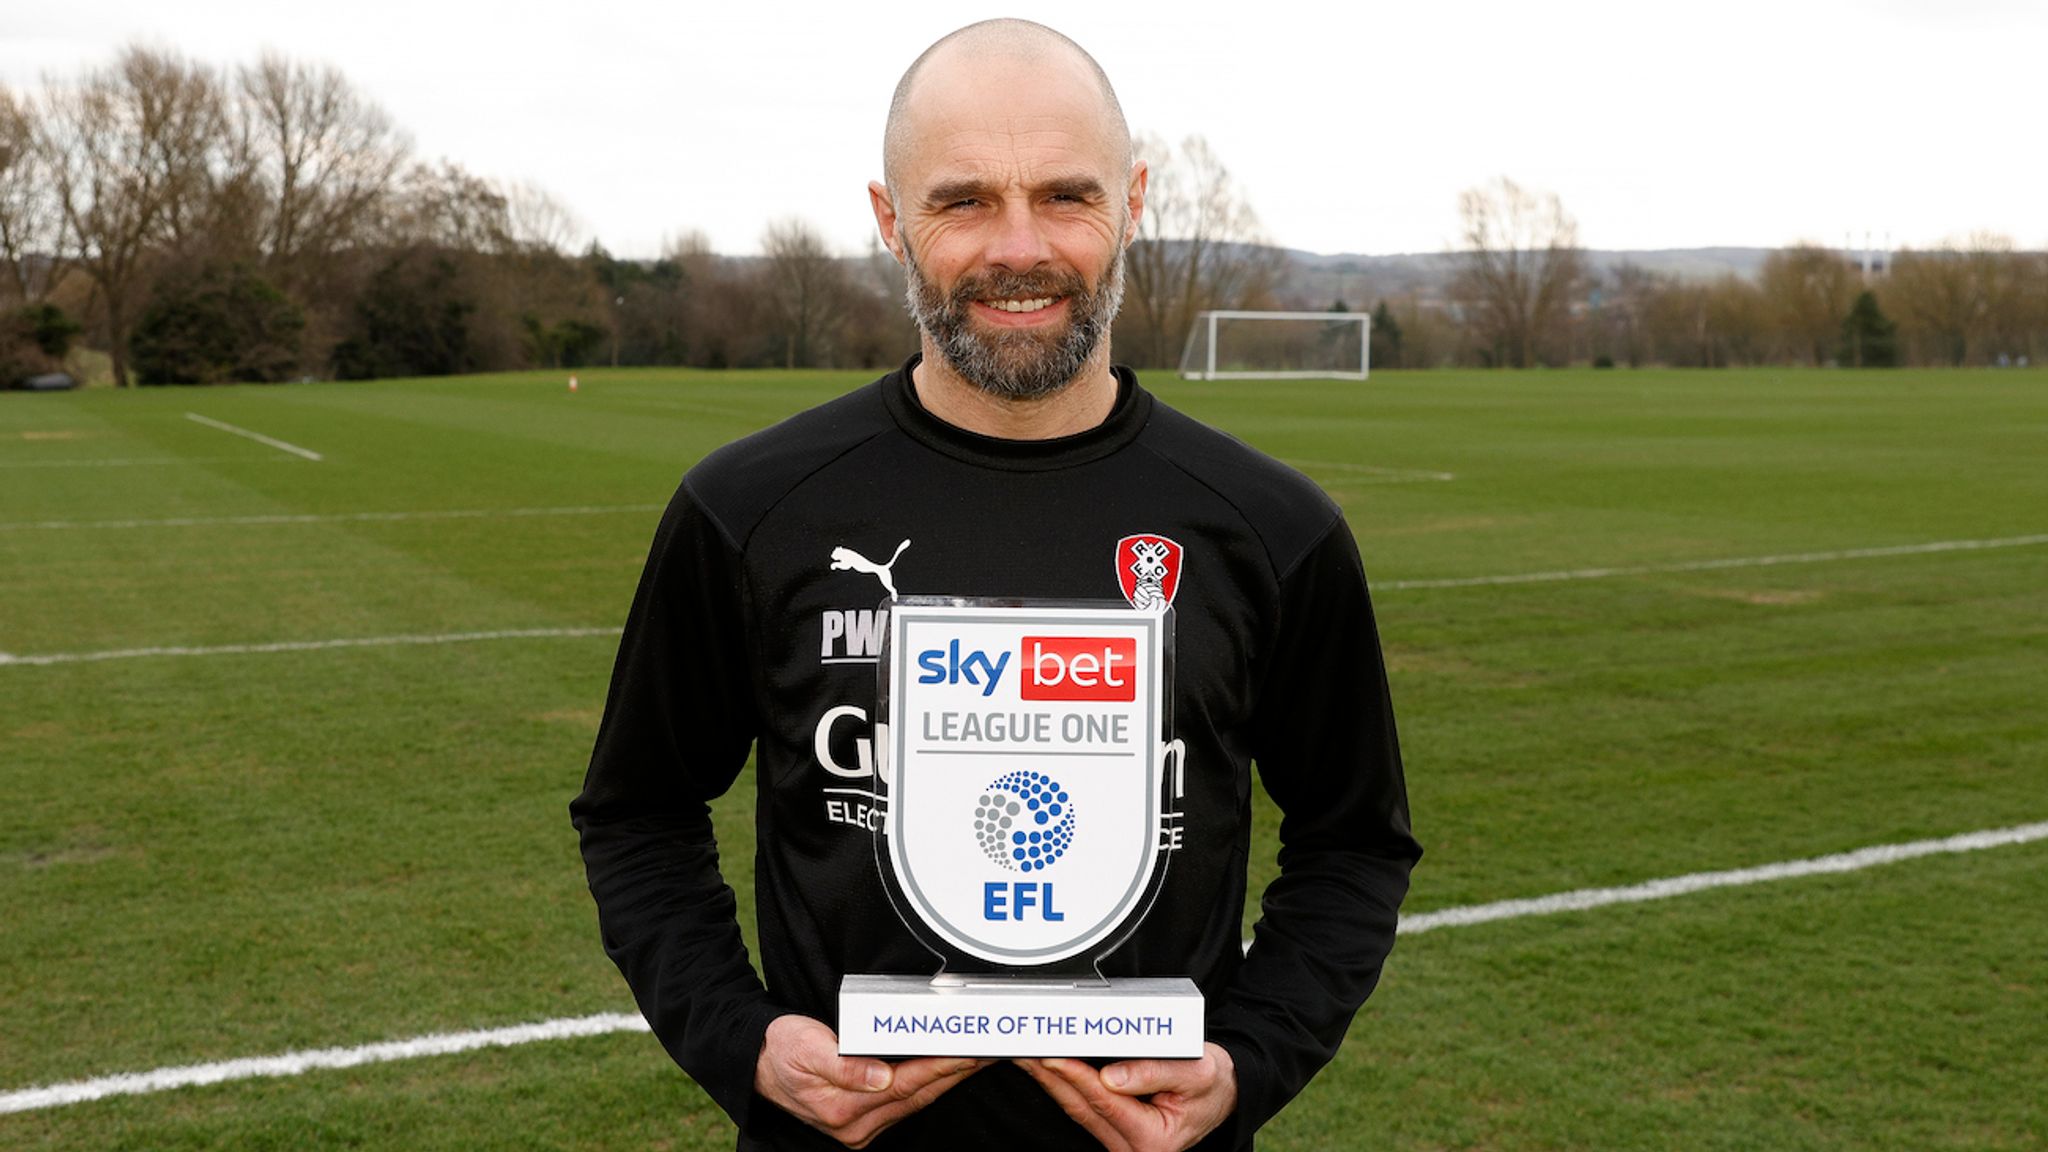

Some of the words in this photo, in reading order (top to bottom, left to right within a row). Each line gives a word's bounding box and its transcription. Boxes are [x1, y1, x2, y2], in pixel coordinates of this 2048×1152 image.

[917, 638, 1011, 697] sky
[1032, 642, 1124, 687] bet
[922, 711, 1052, 743] LEAGUE
[1061, 714, 1129, 744] ONE
[983, 882, 1064, 922] EFL
[873, 1015, 990, 1034] MANAGER
[997, 1016, 1028, 1035] OF
[1033, 1016, 1077, 1035] THE
[1085, 1016, 1173, 1036] MONTH
